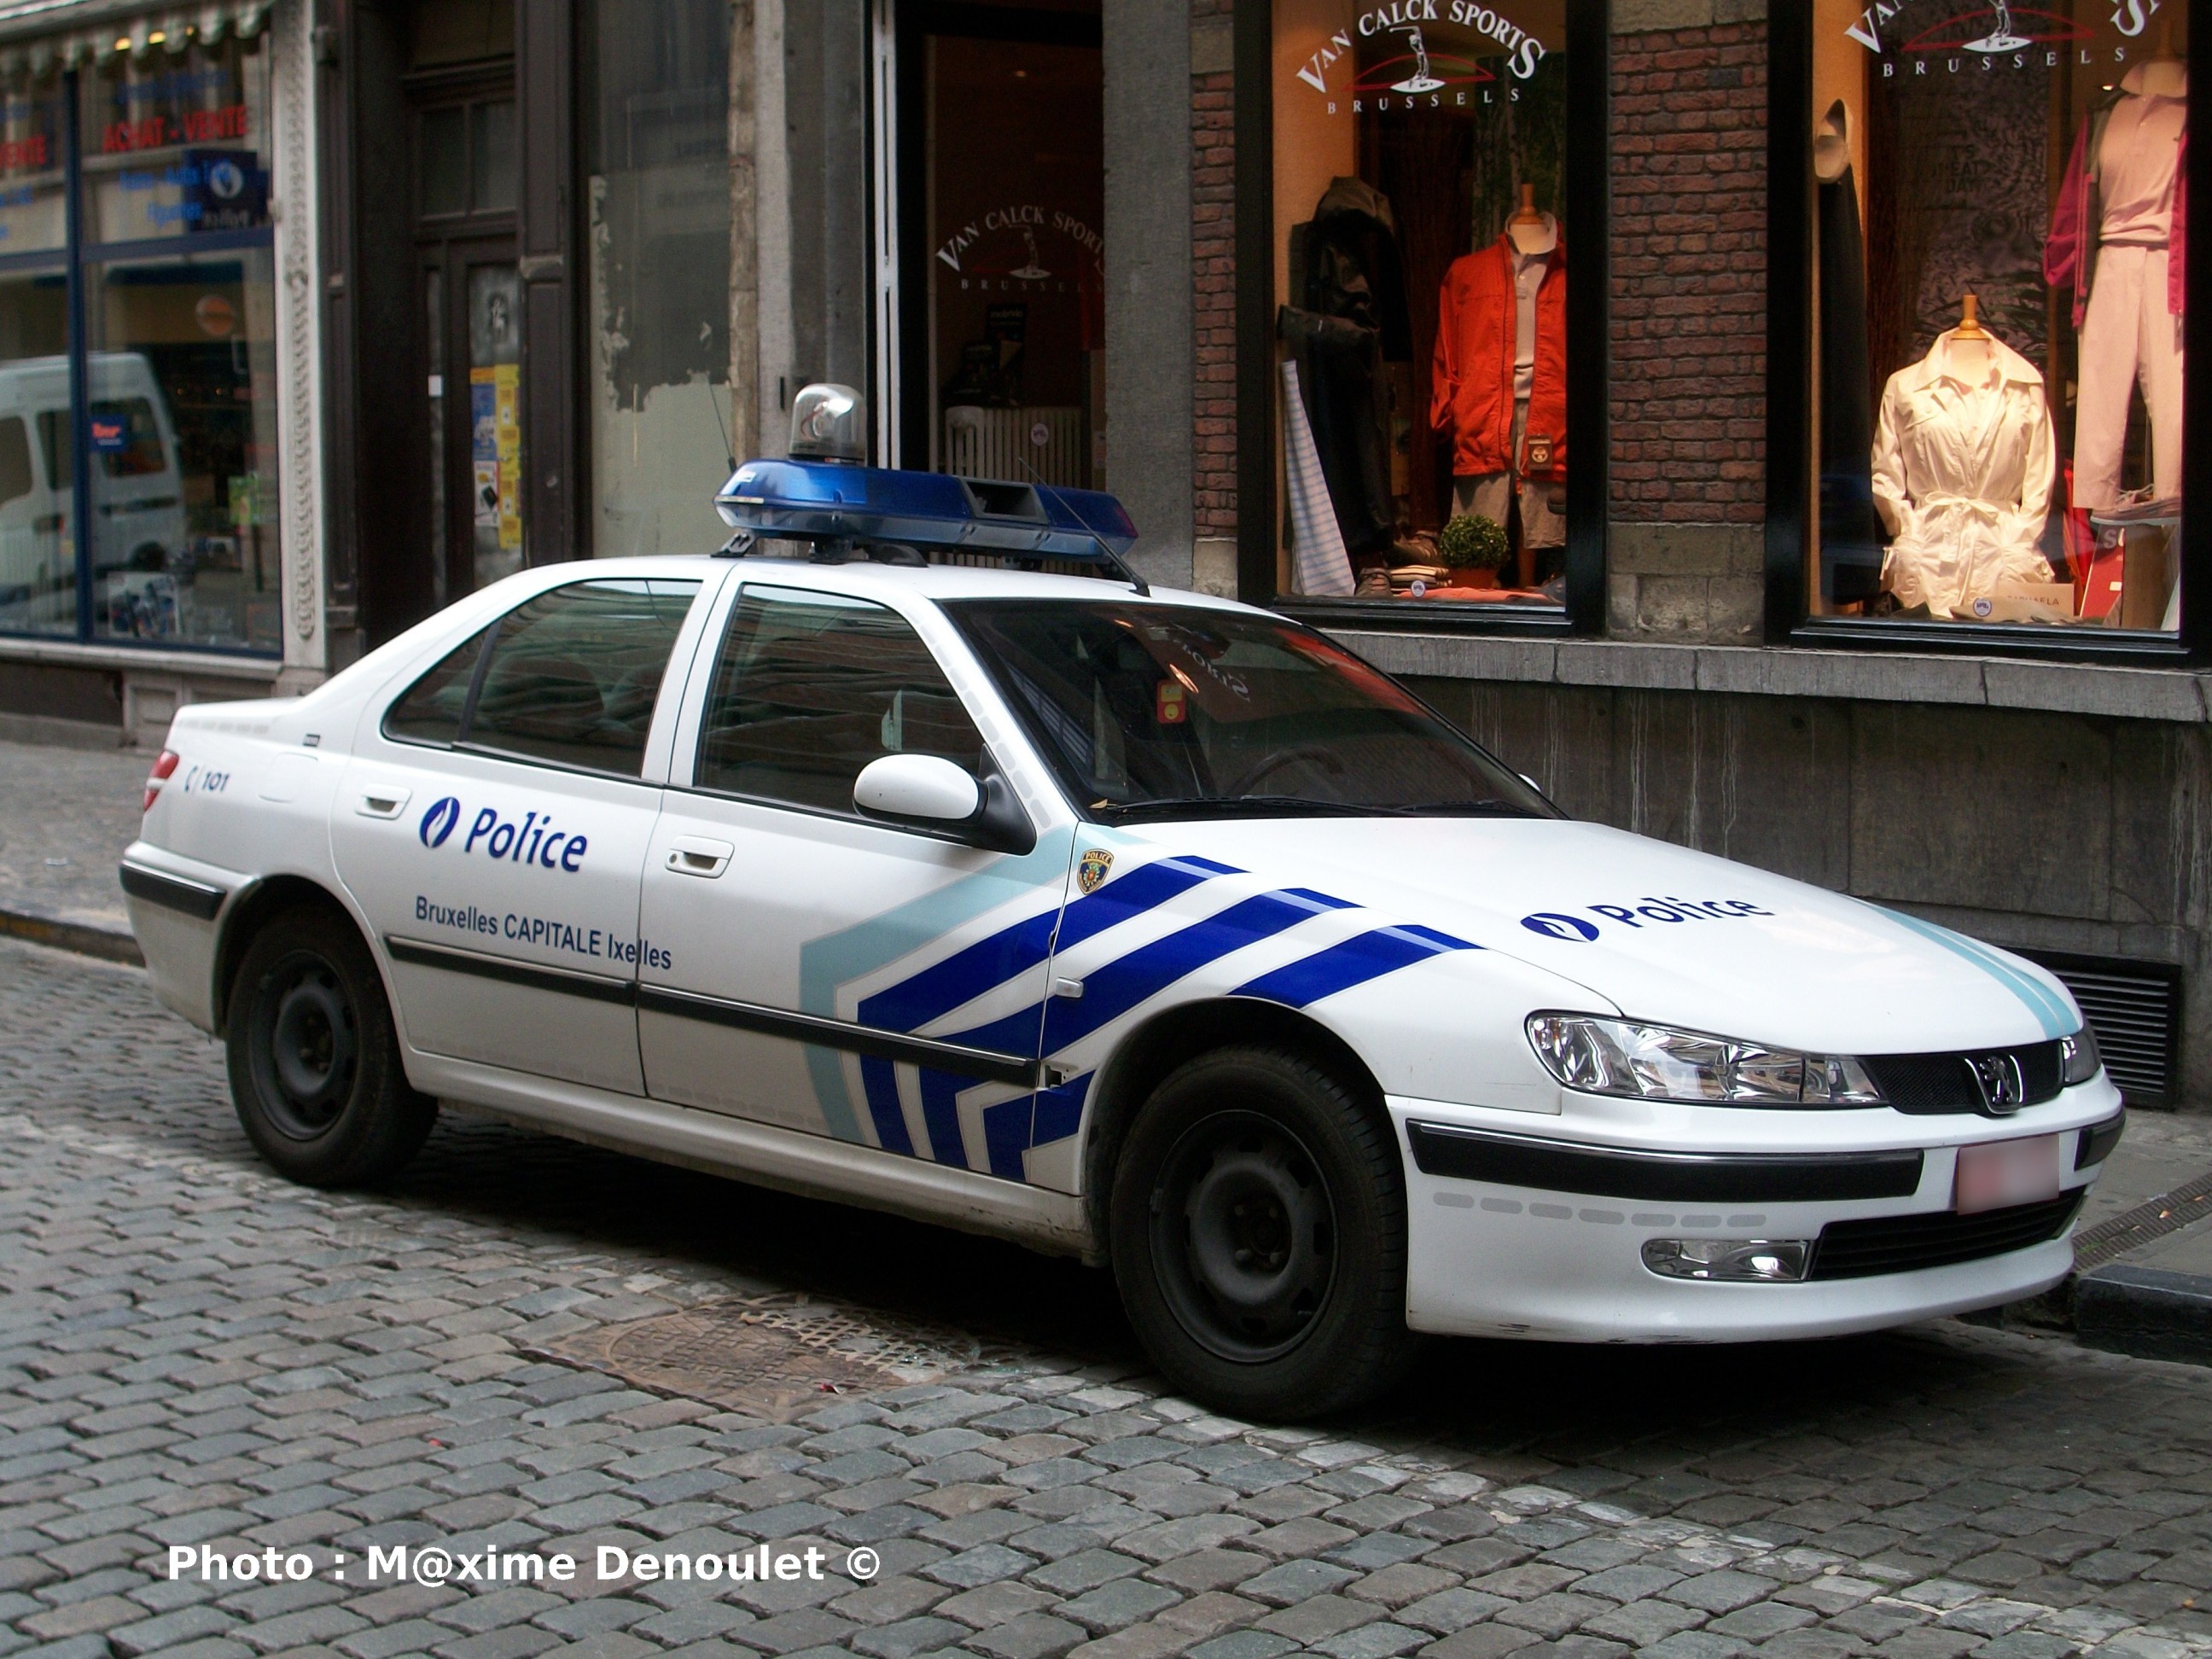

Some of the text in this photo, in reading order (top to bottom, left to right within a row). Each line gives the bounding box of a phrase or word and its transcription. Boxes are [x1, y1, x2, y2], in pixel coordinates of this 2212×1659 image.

[1296, 0, 1546, 94] VAN CALCK SPORTS
[1883, 47, 2125, 78] BRUSSELS
[1327, 88, 1519, 114] BRUSSELS
[183, 105, 247, 143] VENTE
[935, 221, 980, 273] VAN
[985, 205, 1045, 231] CALCK
[201, 771, 230, 792] 101
[464, 807, 587, 872] Police
[1086, 852, 1111, 864] POLICE
[1585, 896, 1776, 928] Police
[416, 895, 672, 970] Bruxelles CAPITALE Ixelles
